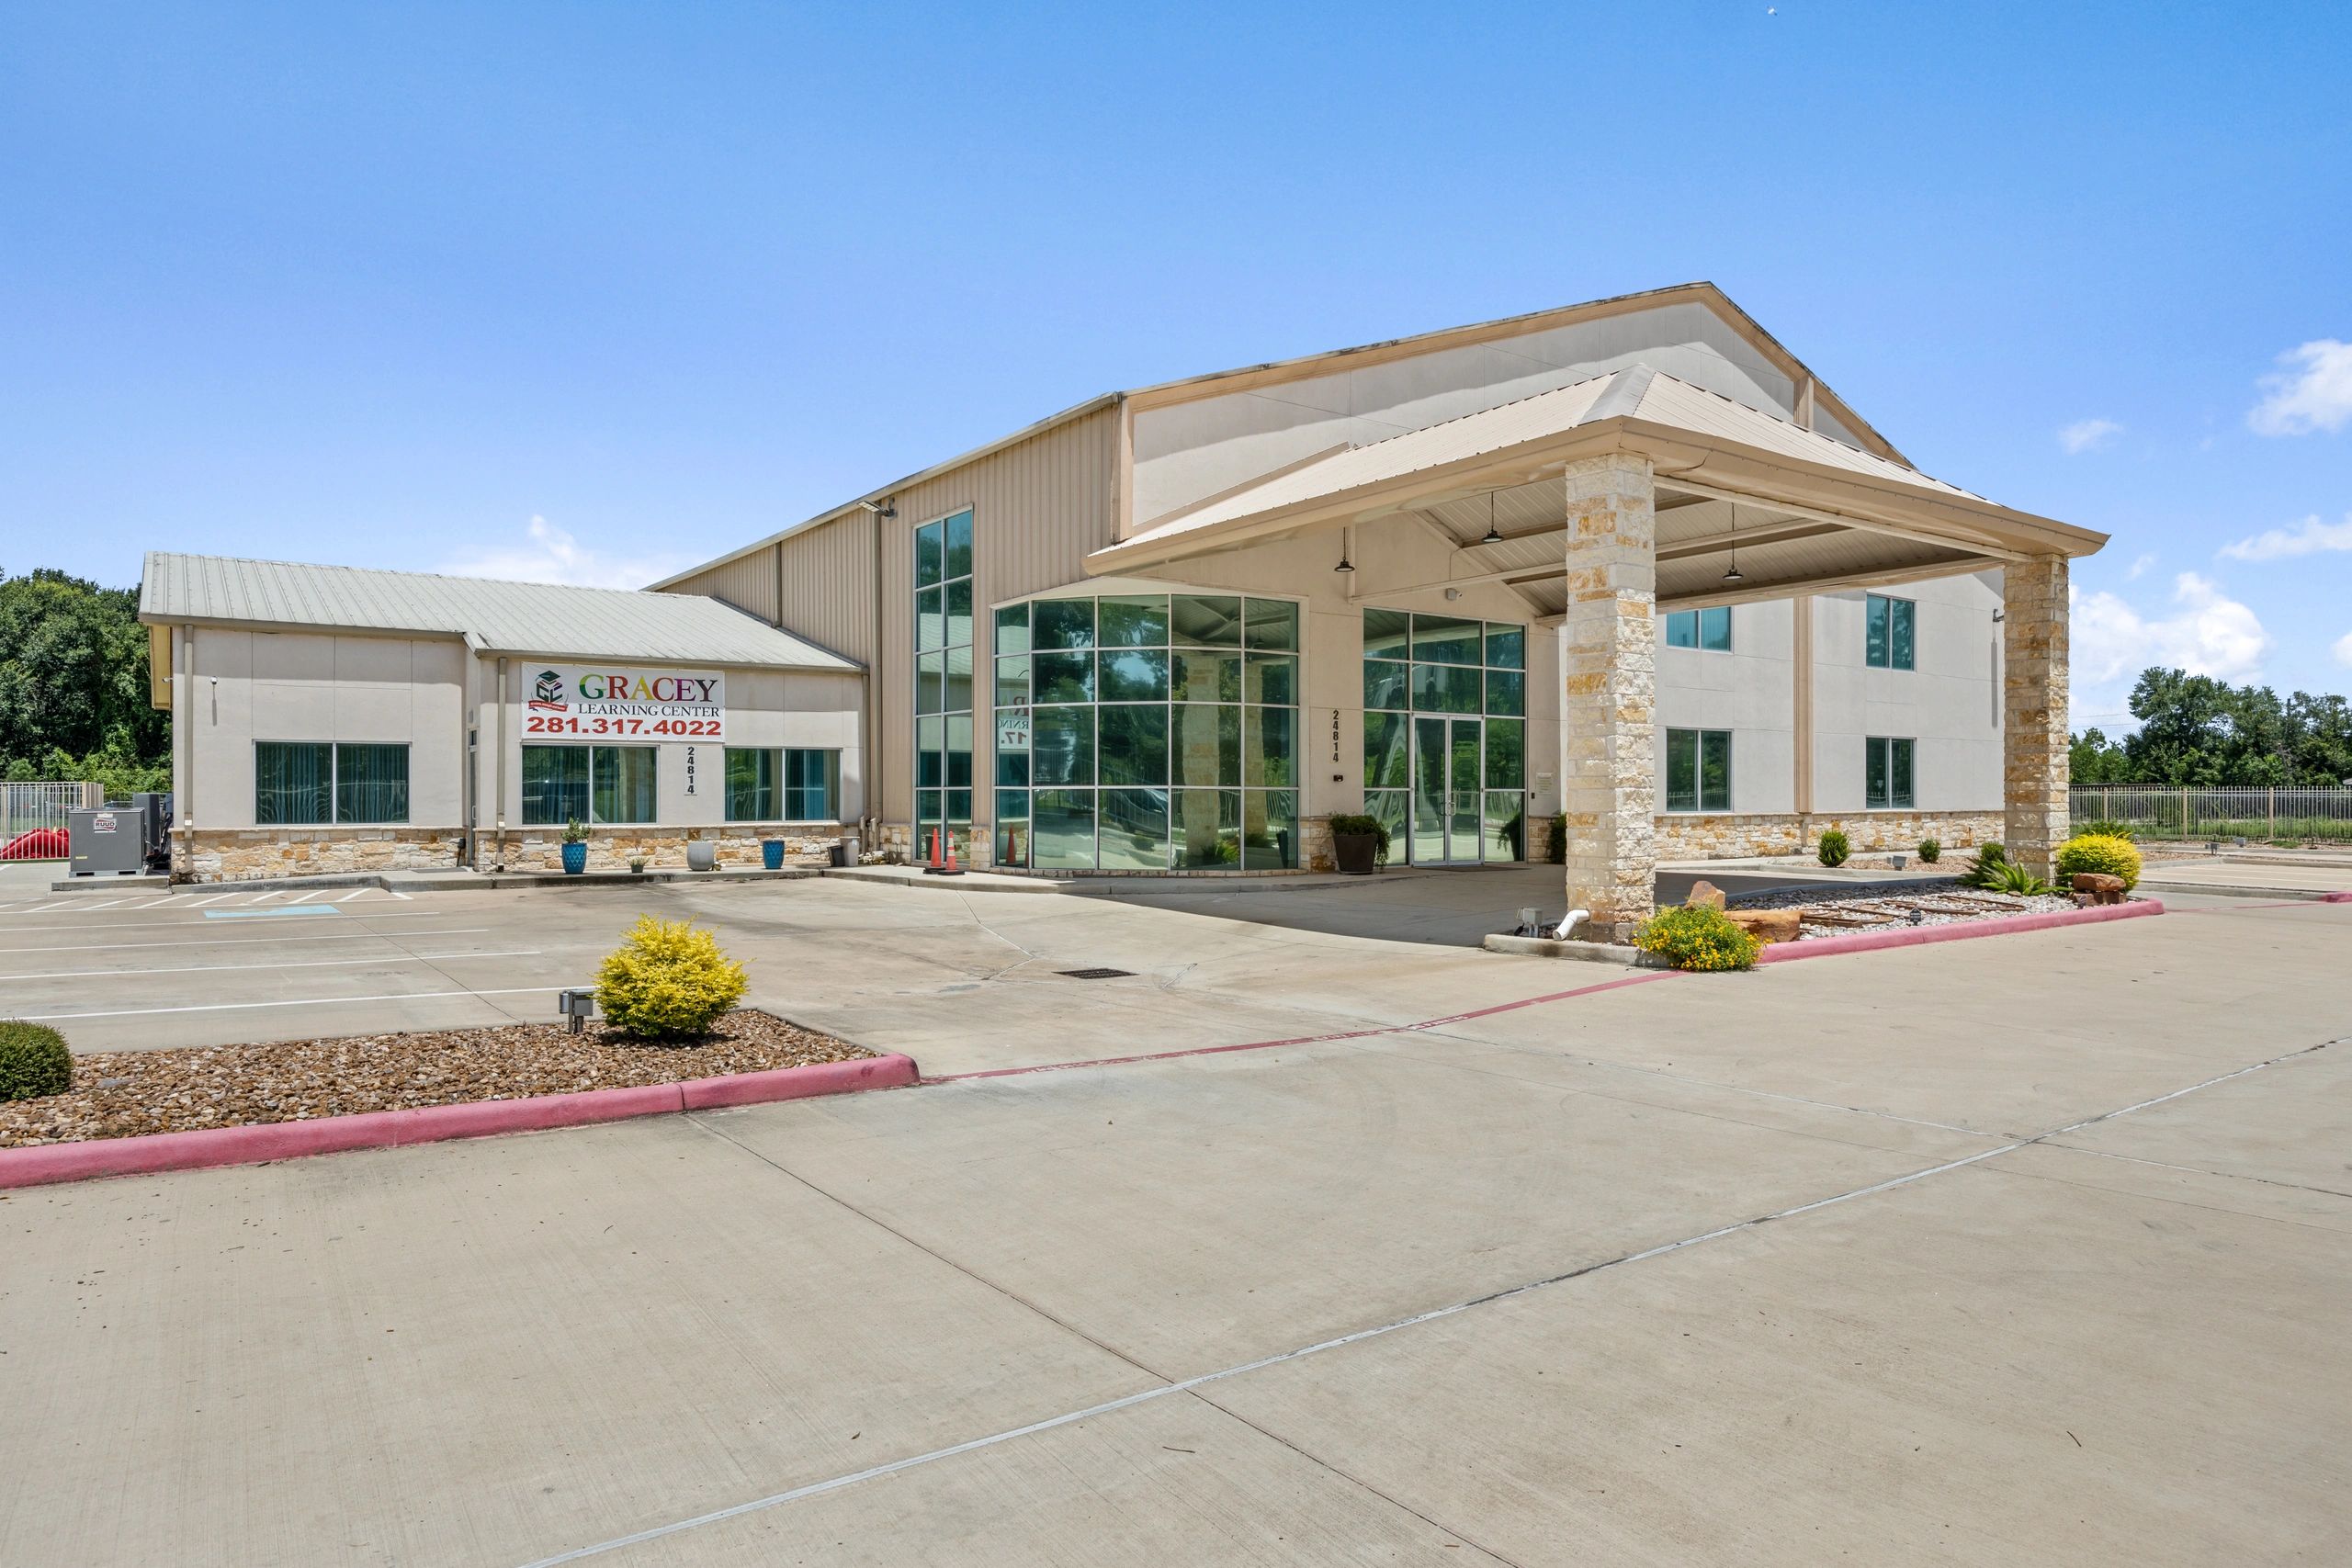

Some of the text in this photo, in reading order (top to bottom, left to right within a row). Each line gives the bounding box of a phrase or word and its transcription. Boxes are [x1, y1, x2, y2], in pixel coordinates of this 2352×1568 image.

[579, 673, 718, 703] GRACEY
[579, 705, 658, 716] LEARNING
[662, 705, 719, 717] CENTER
[527, 716, 721, 736] 281.317.4022
[686, 747, 695, 794] 24814
